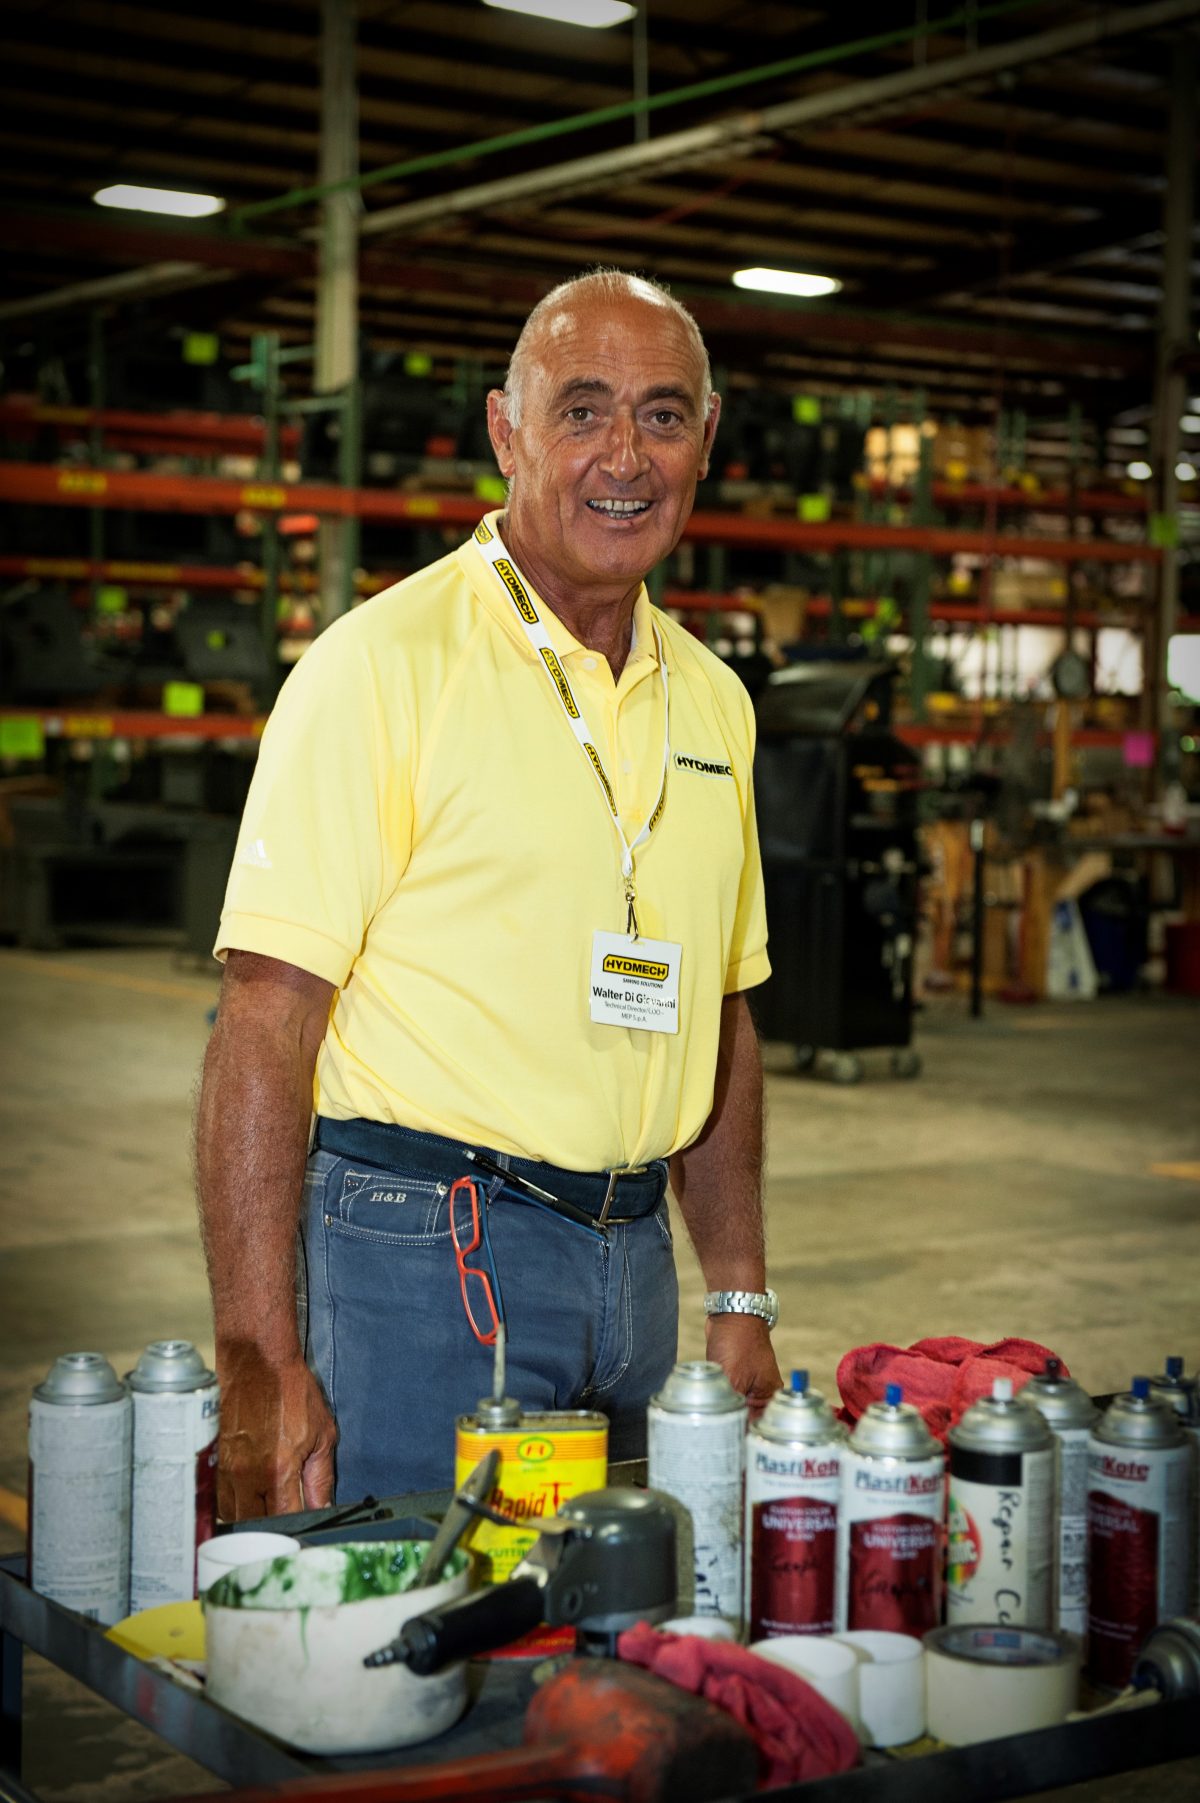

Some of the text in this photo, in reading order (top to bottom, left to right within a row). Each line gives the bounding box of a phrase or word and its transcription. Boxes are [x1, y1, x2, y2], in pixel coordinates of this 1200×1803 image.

[497, 561, 534, 621] HYDMECH
[544, 650, 576, 715] HYDMECH
[677, 755, 733, 777] HYDMEC
[605, 959, 666, 977] HYDMECH
[592, 986, 623, 1001] Walter
[625, 991, 635, 1002] Di
[369, 1191, 407, 1203] H&B
[489, 1486, 547, 1520] Rapid
